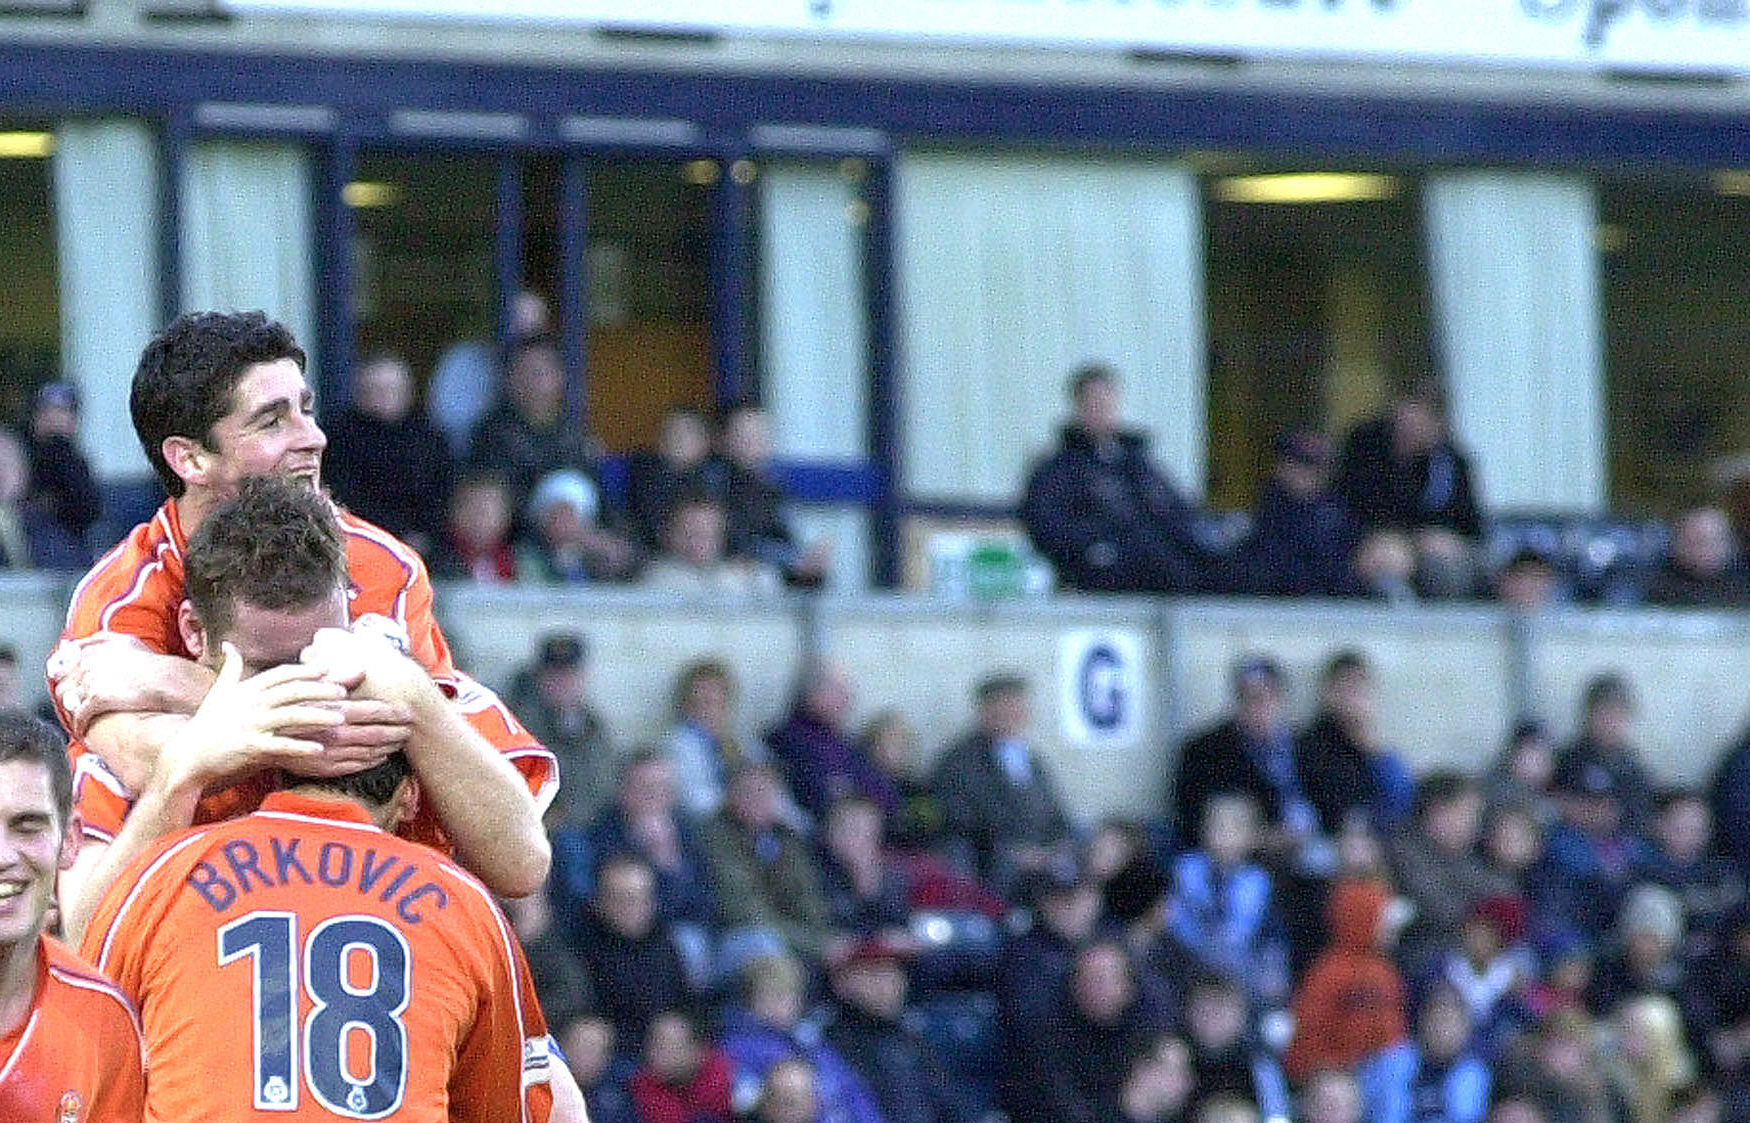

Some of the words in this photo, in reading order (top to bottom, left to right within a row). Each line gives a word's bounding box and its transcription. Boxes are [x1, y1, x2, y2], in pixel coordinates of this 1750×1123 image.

[1077, 642, 1125, 730] G
[187, 837, 449, 925] BRKOVIC
[216, 909, 413, 1121] 18
